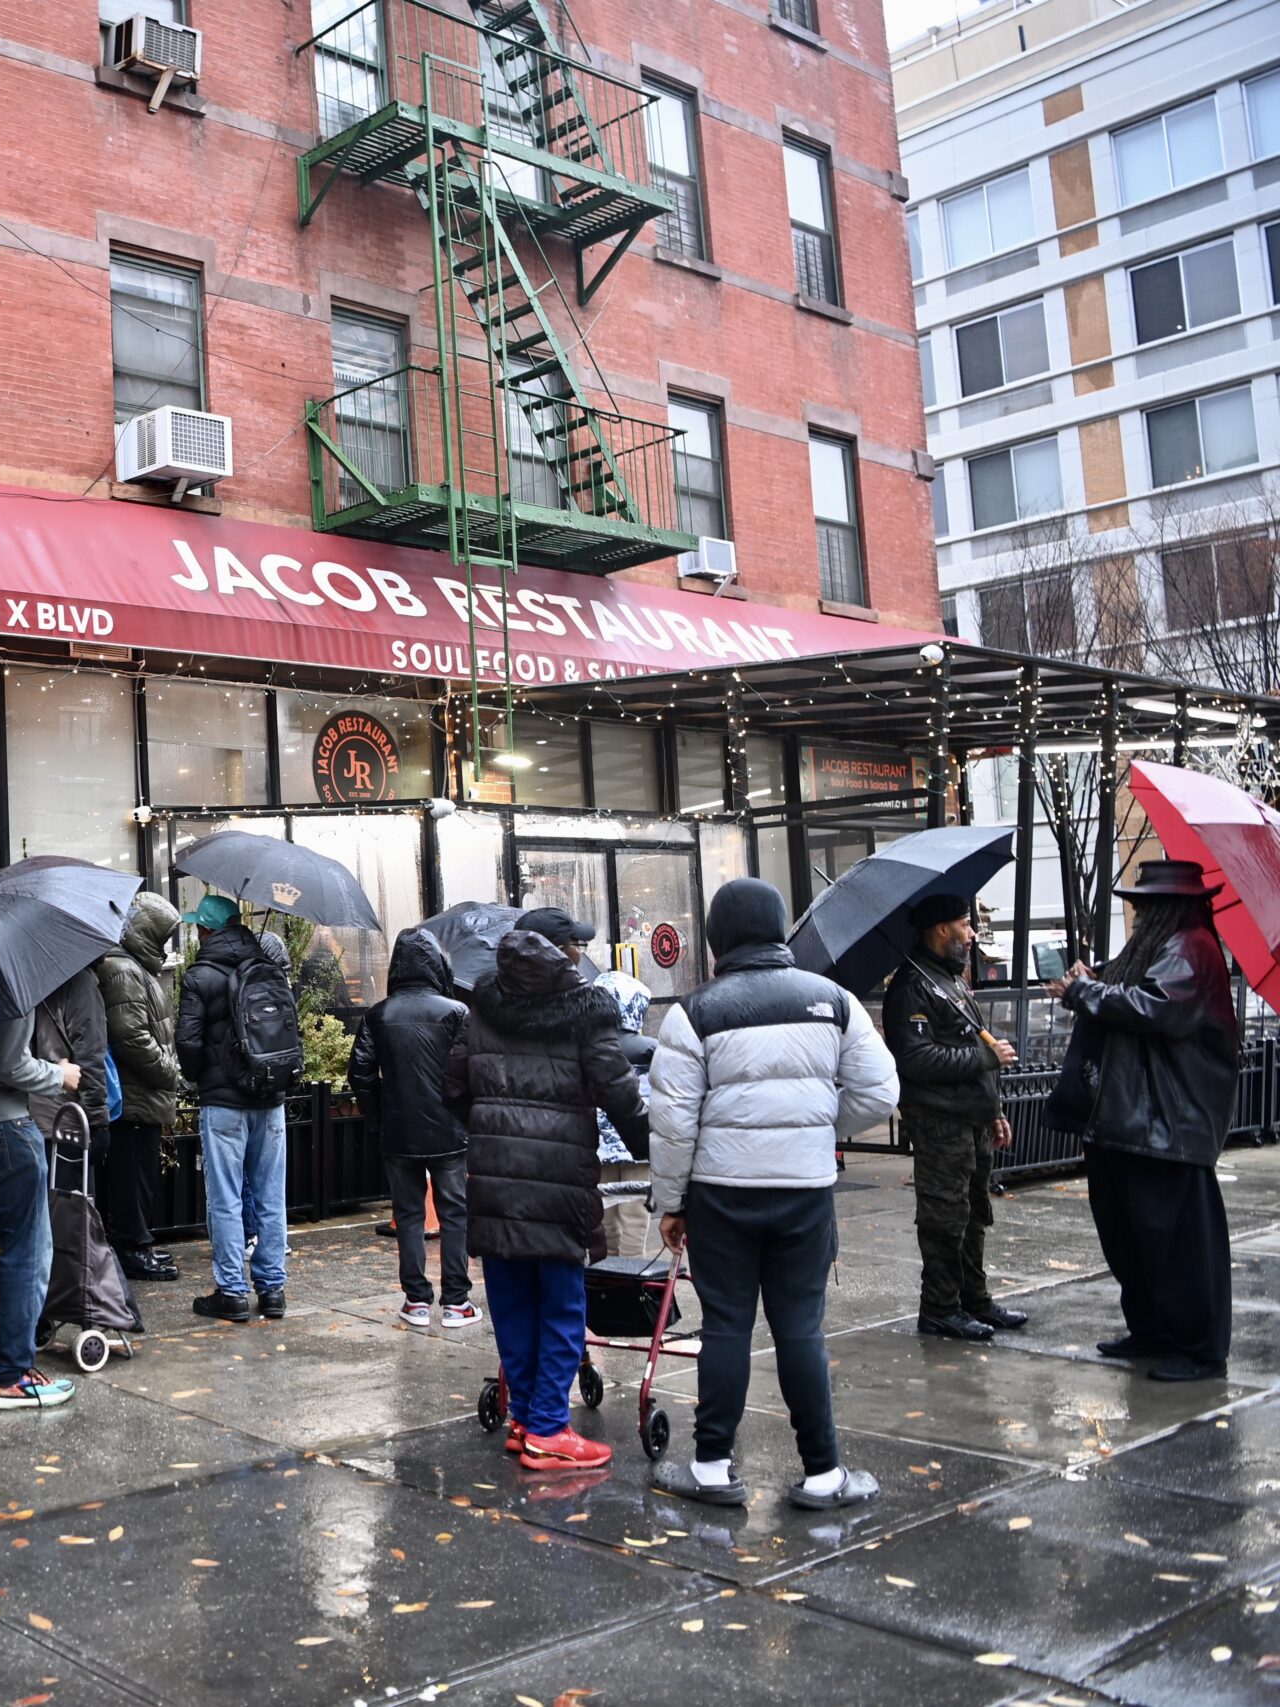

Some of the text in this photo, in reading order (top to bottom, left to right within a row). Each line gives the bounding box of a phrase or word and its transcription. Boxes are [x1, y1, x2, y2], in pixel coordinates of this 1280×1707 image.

[7, 599, 30, 629] X
[37, 603, 114, 637] BLVD
[171, 539, 800, 662] JACOB RESTAURANT
[391, 640, 470, 676] SOUL
[475, 649, 556, 683] FOOD
[564, 660, 581, 683] &
[317, 717, 399, 775] JACOB RESTAURANT
[343, 749, 375, 790] JR
[820, 758, 908, 778] JACOB RESTAURANT
[831, 777, 844, 787] Soul
[845, 778, 863, 789] Food
[869, 780, 888, 791] Salad
[888, 781, 899, 791] Bar
